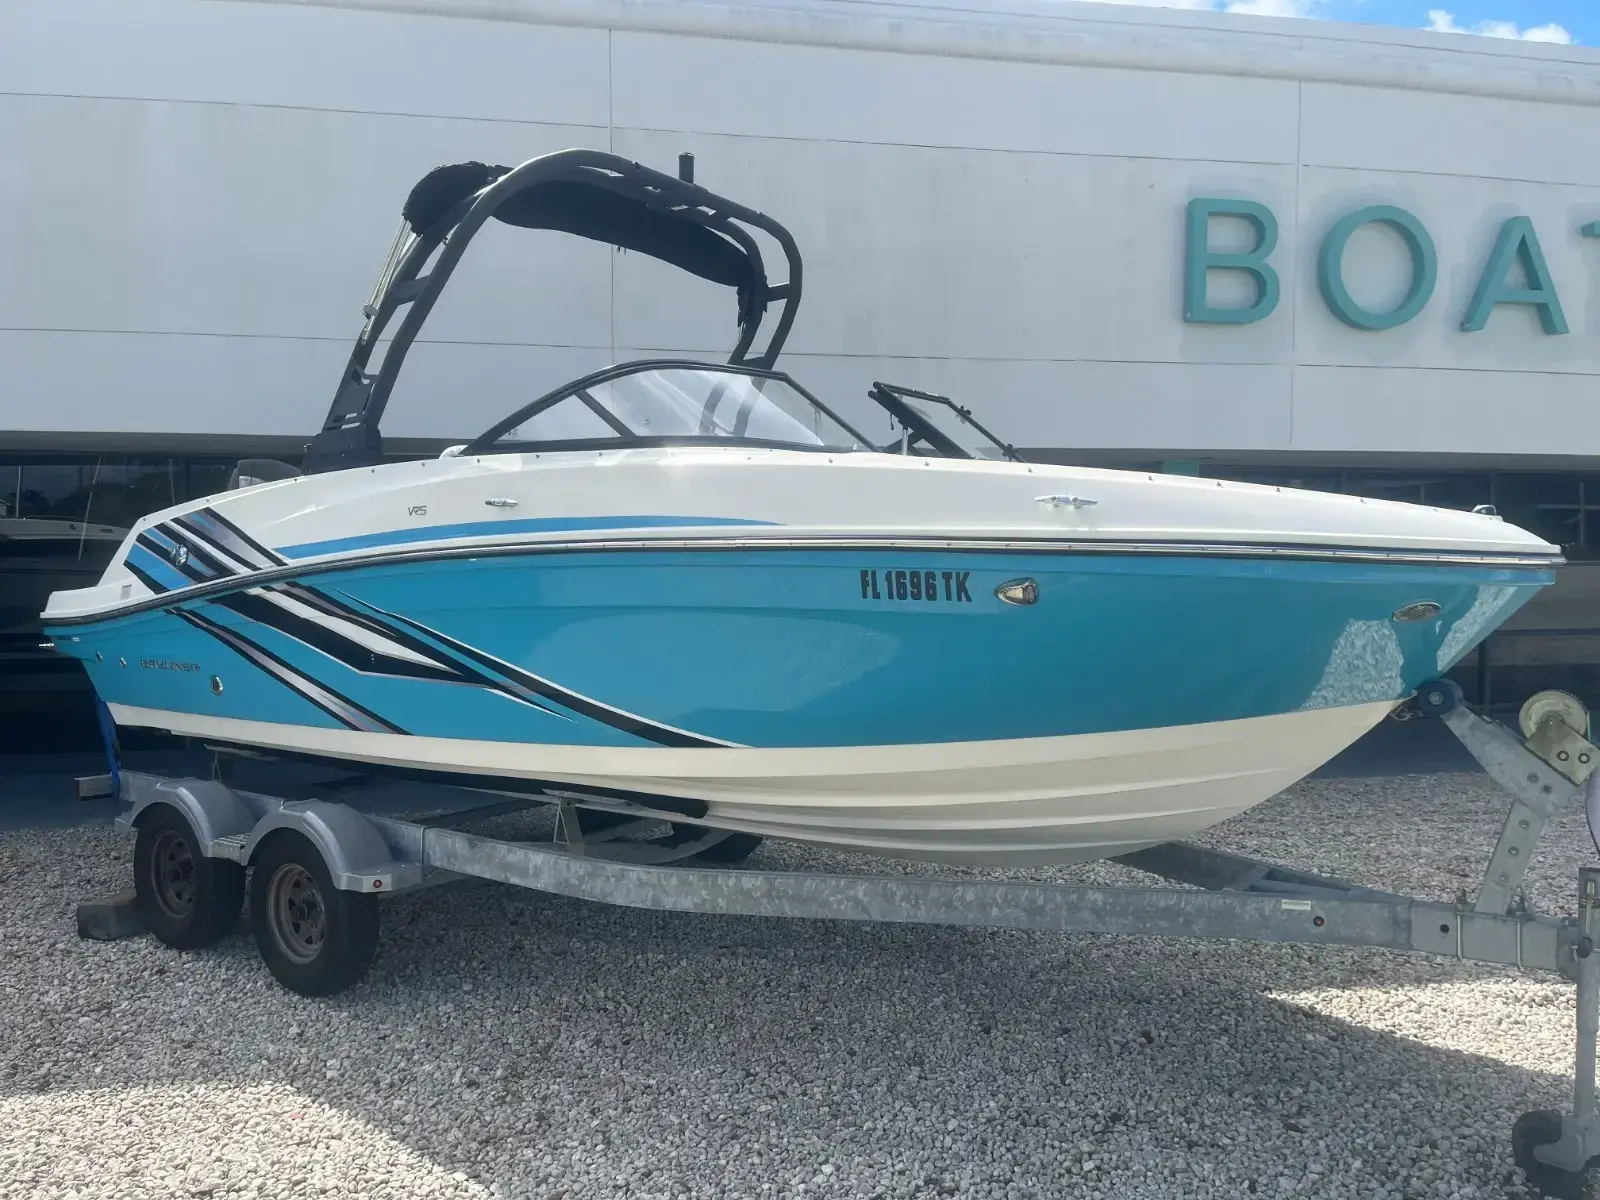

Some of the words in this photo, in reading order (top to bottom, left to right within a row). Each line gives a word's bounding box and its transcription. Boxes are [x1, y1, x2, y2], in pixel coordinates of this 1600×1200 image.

[1184, 197, 1600, 335] BOA
[860, 569, 880, 600] FL
[884, 570, 937, 602] 1696
[942, 571, 973, 603] TK
